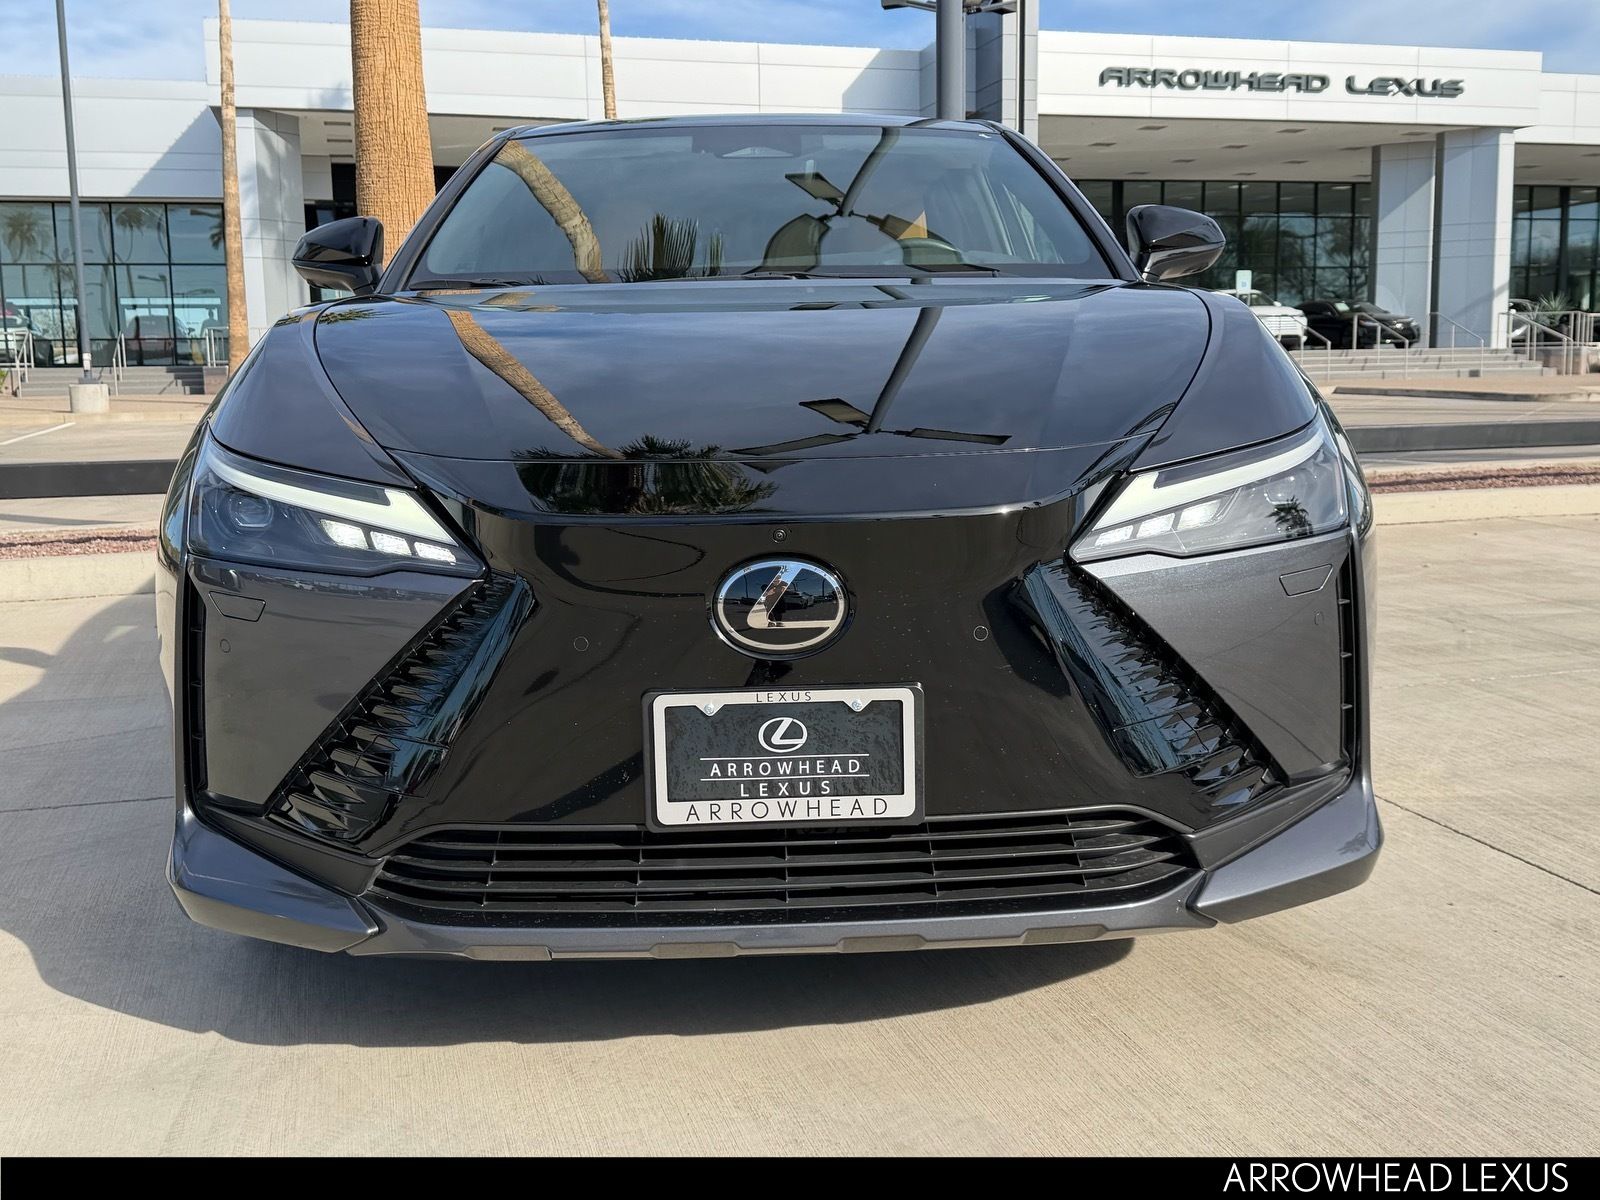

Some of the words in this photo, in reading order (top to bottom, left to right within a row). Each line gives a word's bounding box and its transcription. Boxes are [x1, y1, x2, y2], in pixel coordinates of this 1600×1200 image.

[1099, 66, 1330, 93] ARROWHEAD
[1345, 75, 1465, 98] LEXUS
[756, 691, 812, 703] LEXUS
[710, 759, 860, 777] ARROWHEAD
[740, 781, 830, 797] LEXUS
[686, 798, 888, 822] ARROWHEAD
